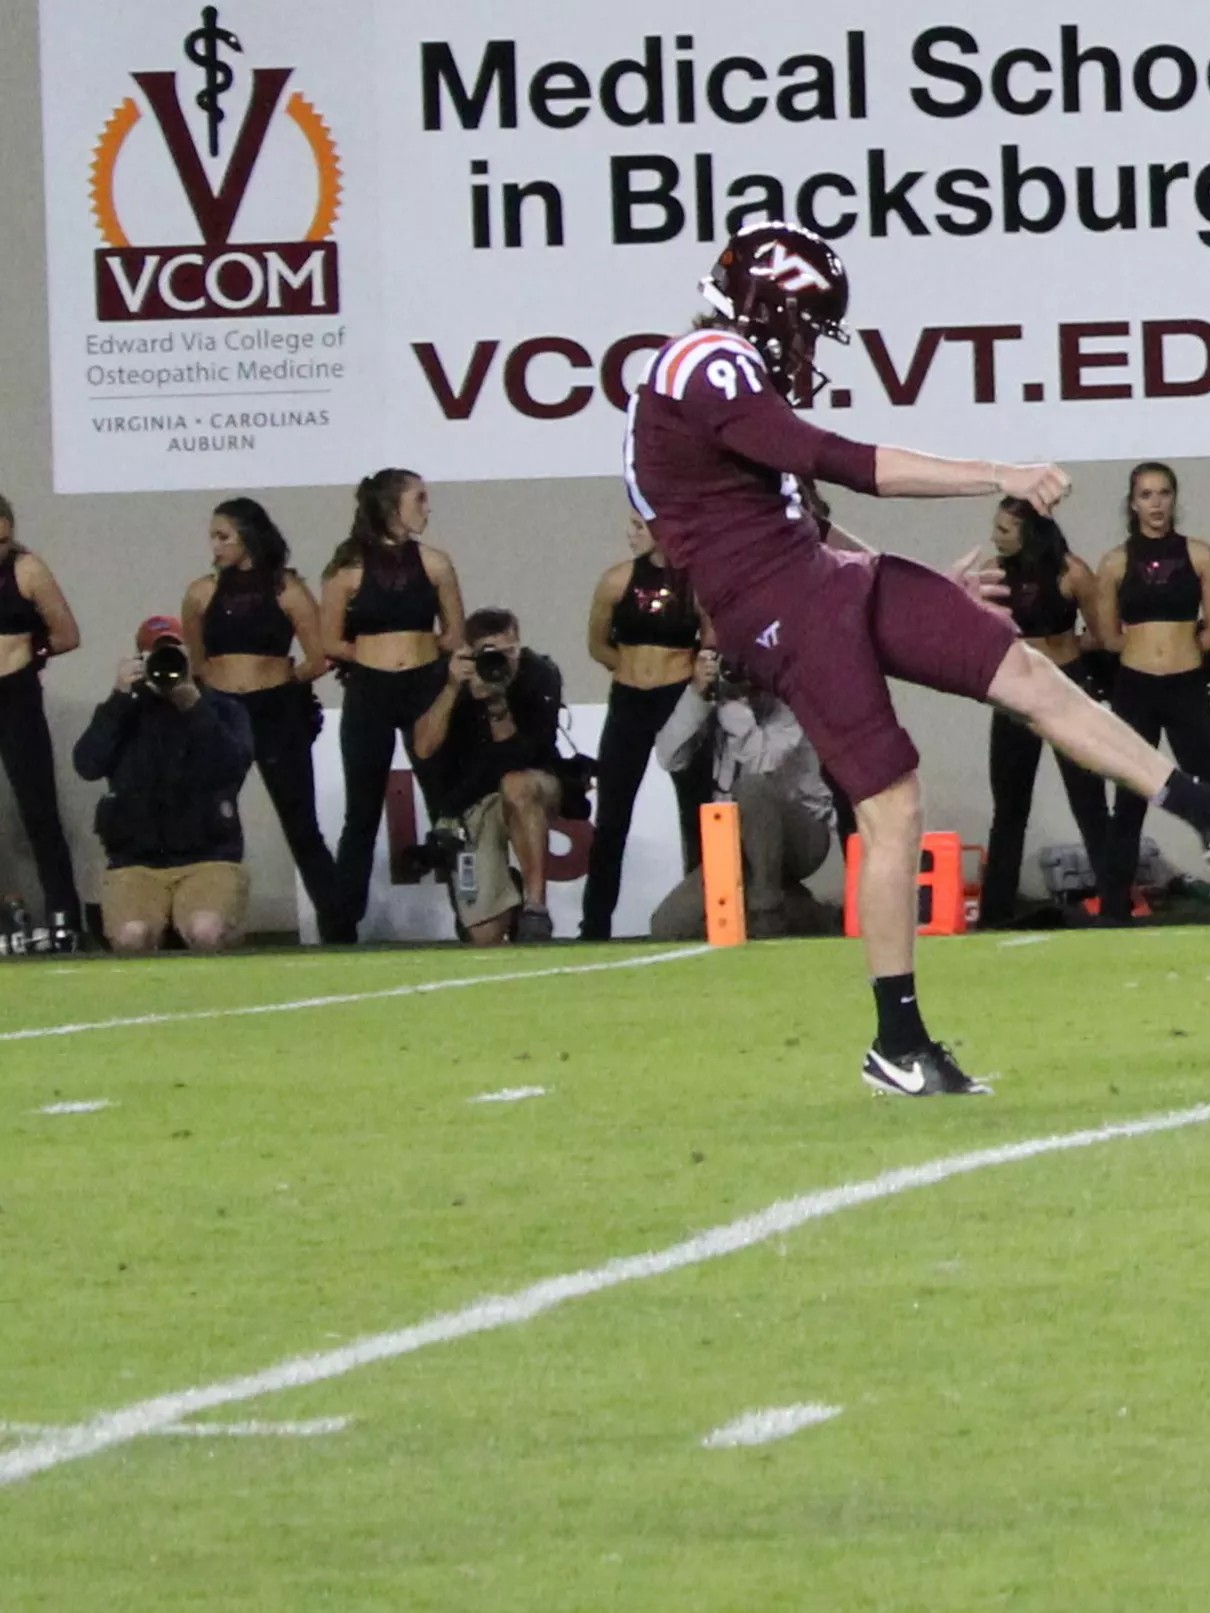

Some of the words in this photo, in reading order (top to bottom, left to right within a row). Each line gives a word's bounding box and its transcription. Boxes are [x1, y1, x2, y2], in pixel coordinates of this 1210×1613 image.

[421, 30, 867, 131] Medical
[470, 159, 564, 249] in
[105, 250, 327, 316] VCOM
[86, 332, 174, 355] Edward
[180, 331, 217, 352] Via
[224, 328, 315, 355] College
[321, 326, 347, 348] of
[86, 362, 230, 388] Osteopathic
[236, 357, 345, 382] Medicine
[705, 353, 763, 401] 91
[91, 415, 188, 433] VIRGINIA
[210, 409, 331, 429] CAROLINAS
[166, 434, 256, 452] AUBURN
